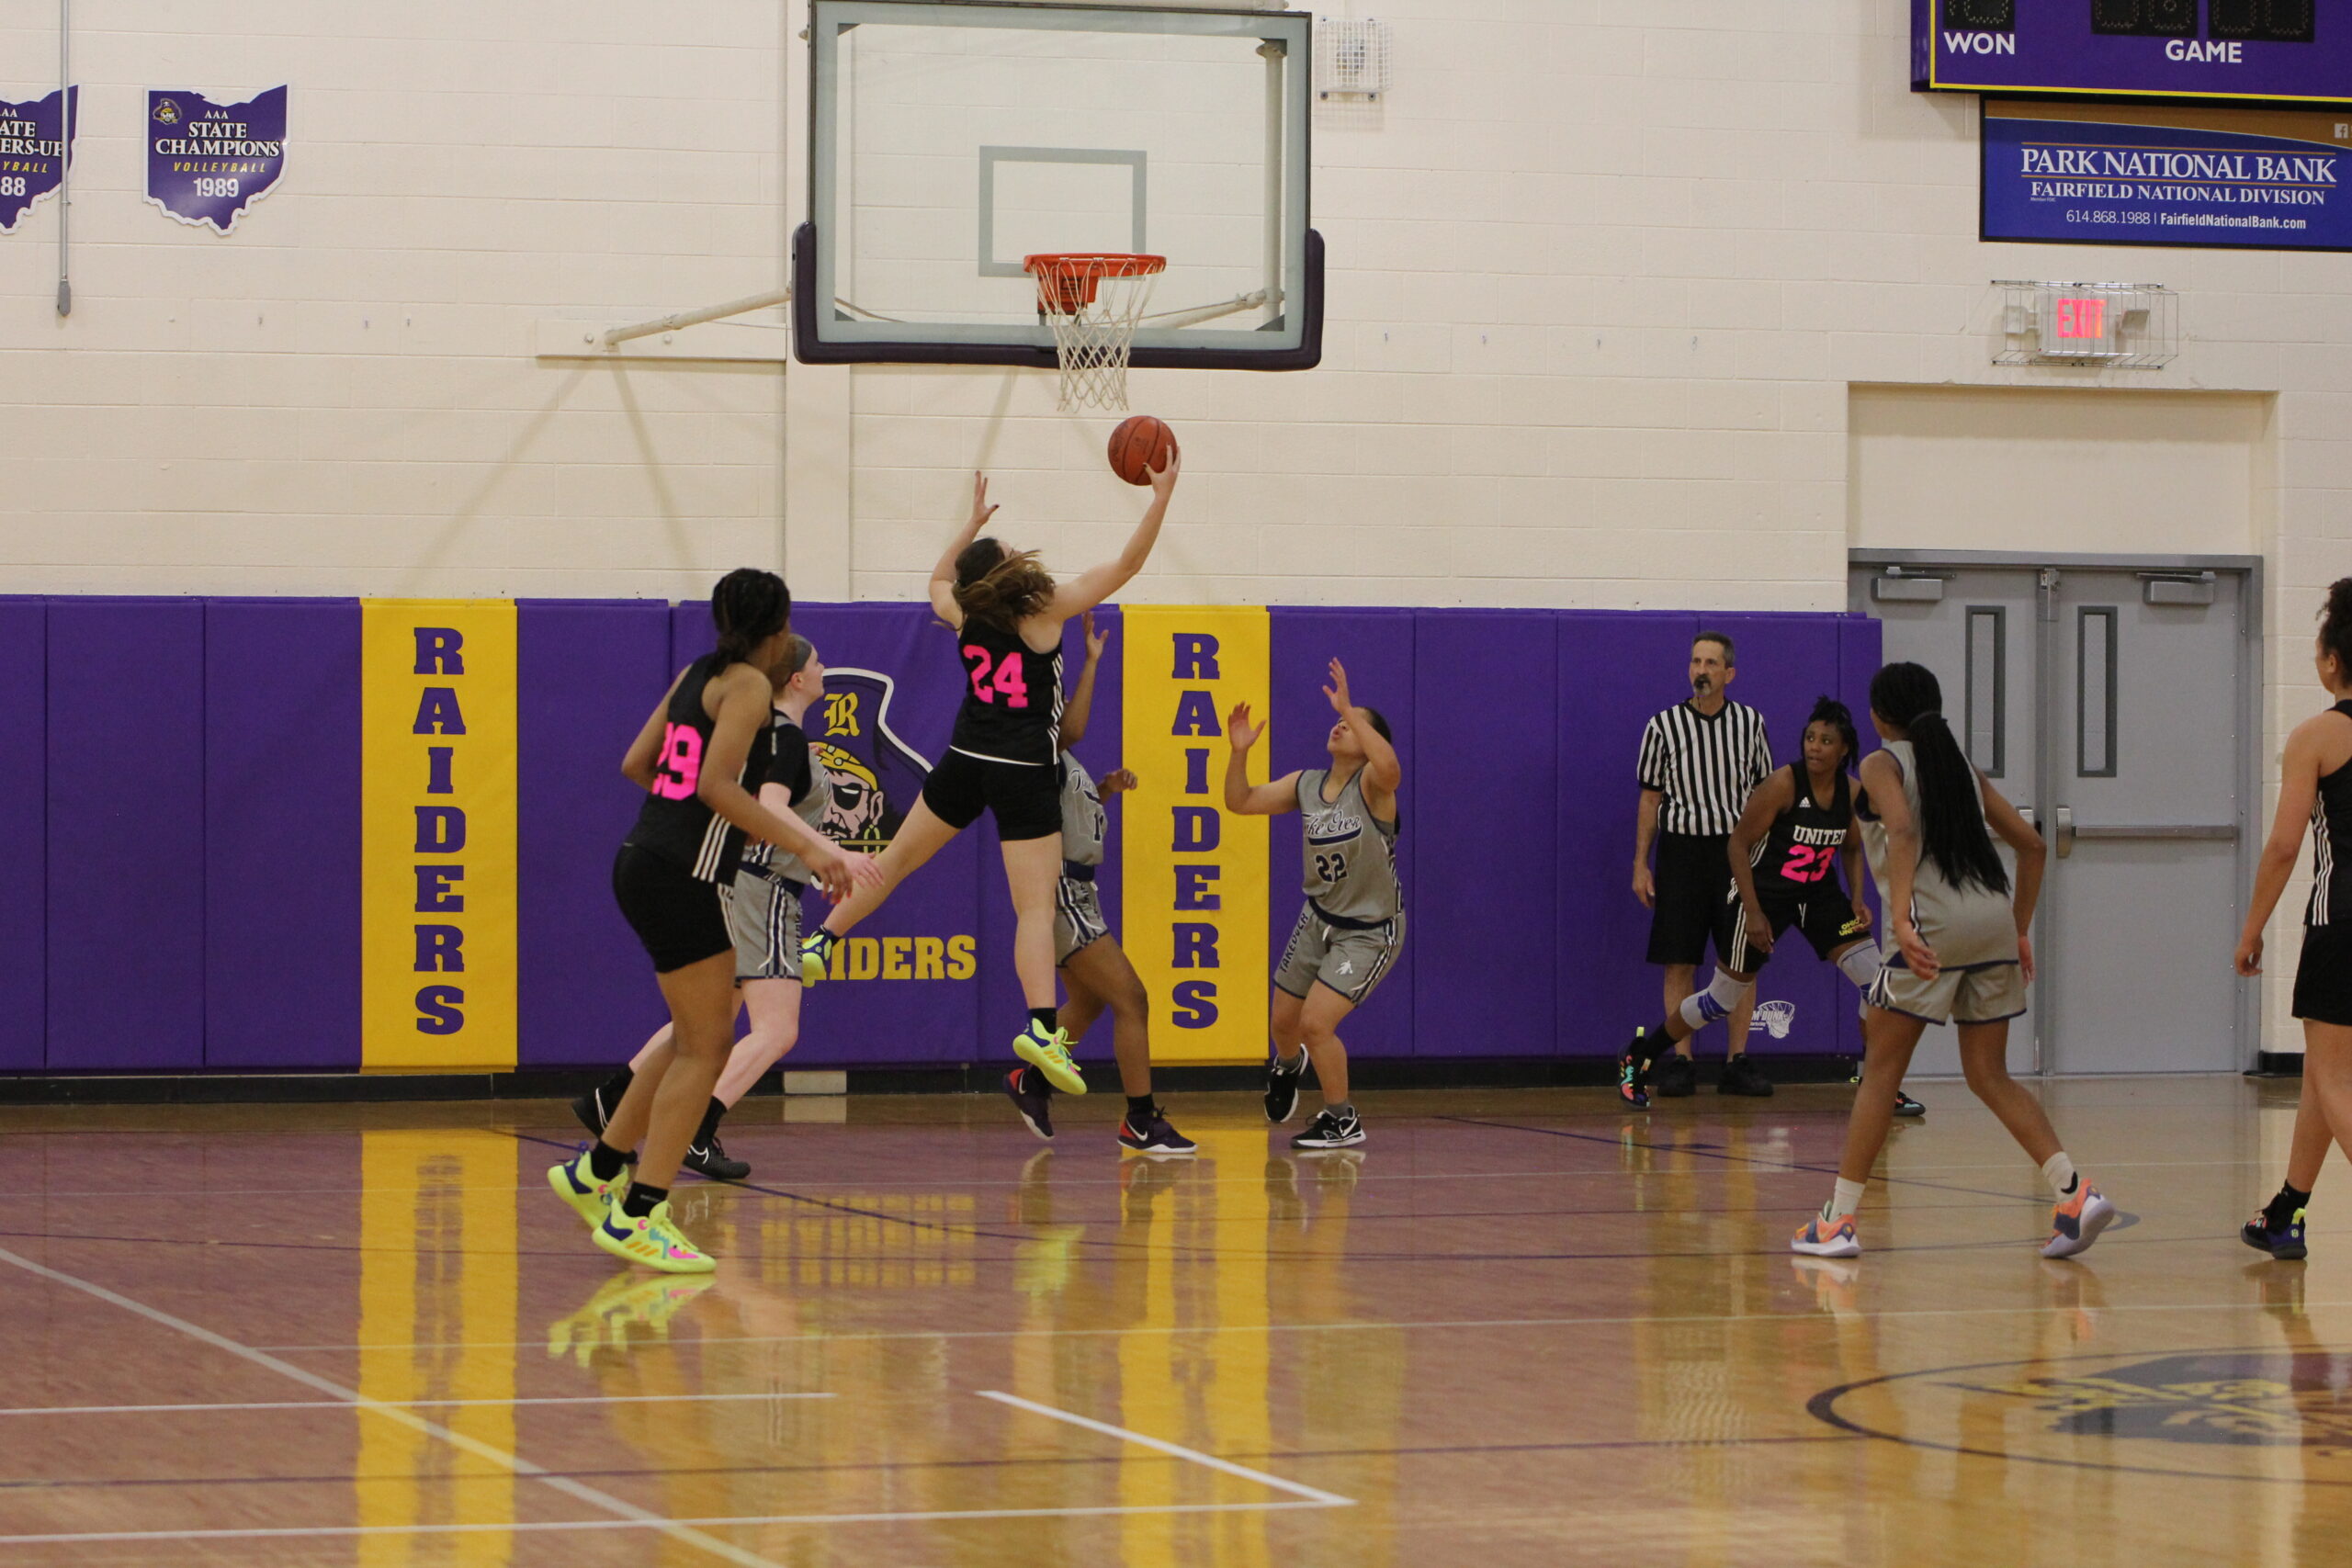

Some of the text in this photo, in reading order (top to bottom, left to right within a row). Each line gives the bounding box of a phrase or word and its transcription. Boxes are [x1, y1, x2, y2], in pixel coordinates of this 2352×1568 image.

[1943, 31, 2016, 55] WON
[2165, 39, 2243, 63] GAME
[0, 107, 18, 118] AA
[204, 109, 229, 119] AAA
[188, 121, 247, 139] STATE
[155, 138, 280, 157] CHAMPIONS
[174, 162, 266, 173] VOLLEYBALL
[2021, 148, 2337, 183] PARK NATIONAL BANK
[193, 177, 240, 197] 1989
[2030, 181, 2325, 206] FAIRFIELD NATIONAL DIVISION
[2065, 209, 2307, 230] 614.868.1988 FairfieldNationalBank.com
[2057, 299, 2107, 339] EXIT
[963, 644, 1029, 708] 24
[823, 692, 861, 737] R
[413, 626, 467, 1036] RAIDERS
[1171, 632, 1222, 1030] RAIDERS
[1315, 852, 1348, 882] 22
[1780, 843, 1837, 884] 23
[801, 934, 977, 981] IDERS
